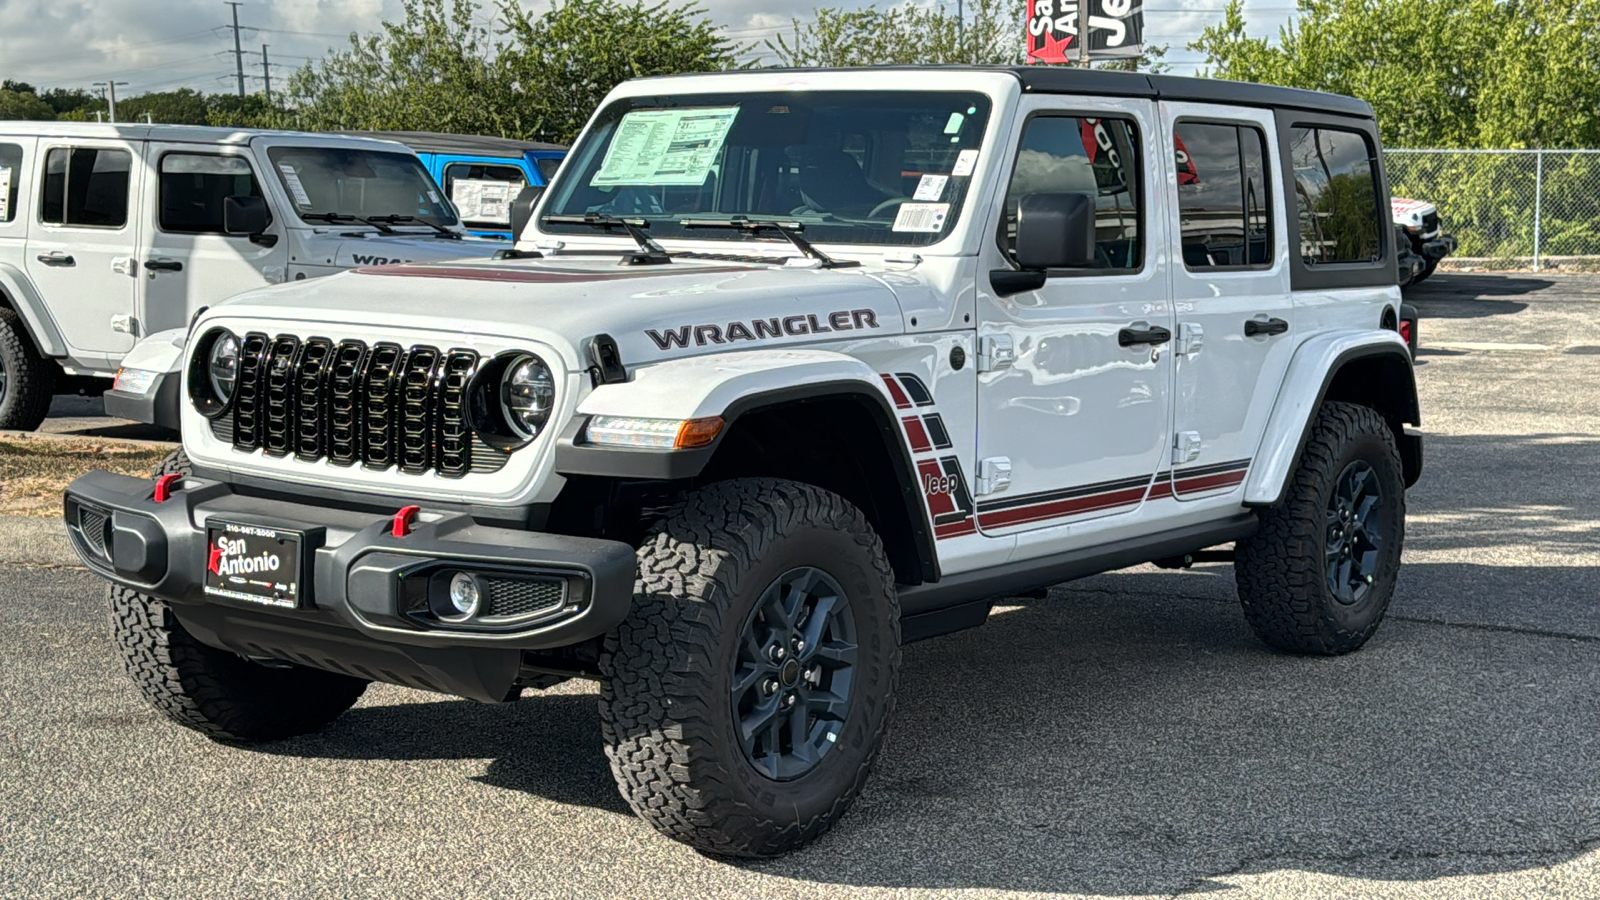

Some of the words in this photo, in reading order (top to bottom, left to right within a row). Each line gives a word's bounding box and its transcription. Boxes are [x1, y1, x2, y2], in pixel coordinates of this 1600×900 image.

[352, 253, 413, 266] WRA
[644, 308, 880, 351] WRANGLER
[924, 473, 959, 496] Jeep
[218, 536, 247, 556] San
[217, 550, 280, 576] Antonio
